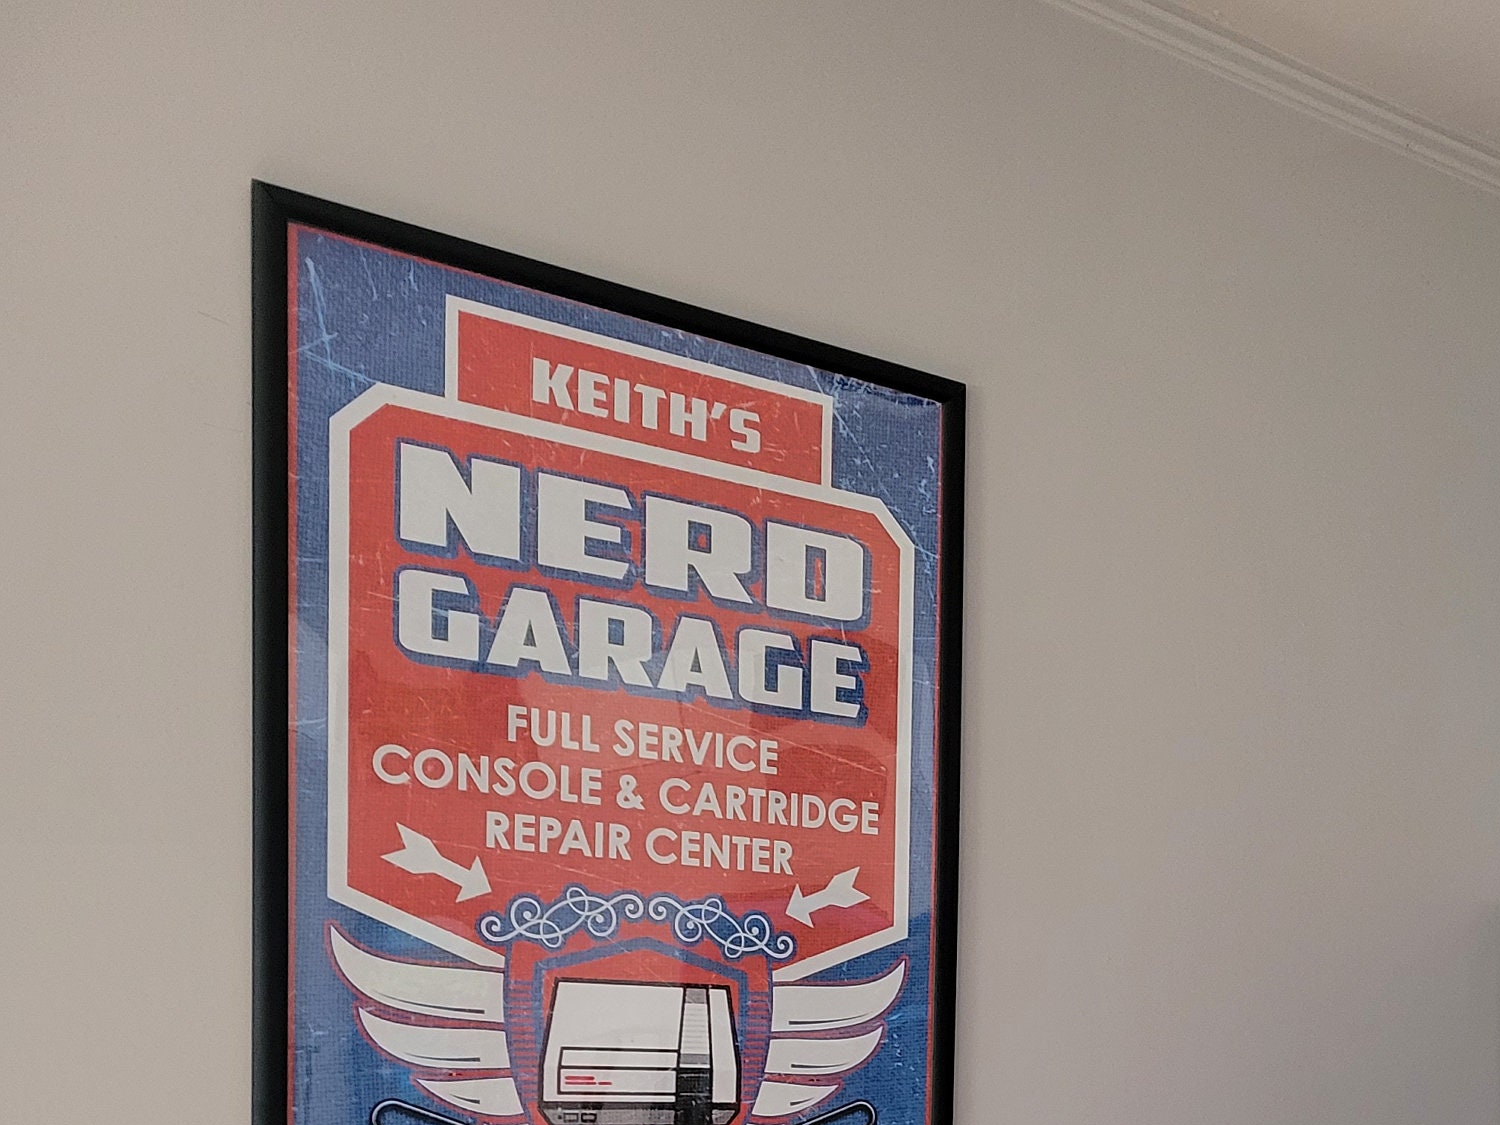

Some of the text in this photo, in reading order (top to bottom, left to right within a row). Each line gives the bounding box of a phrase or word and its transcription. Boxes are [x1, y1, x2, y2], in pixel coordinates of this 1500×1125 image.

[532, 356, 762, 455] KEITH'S
[400, 441, 866, 623] NERD
[398, 568, 862, 719] GARAGE
[507, 704, 779, 775] FULL SERVICE
[372, 743, 880, 836] CONSOLE & CARTRIDGE
[485, 810, 794, 876] REPAIR CENTER
